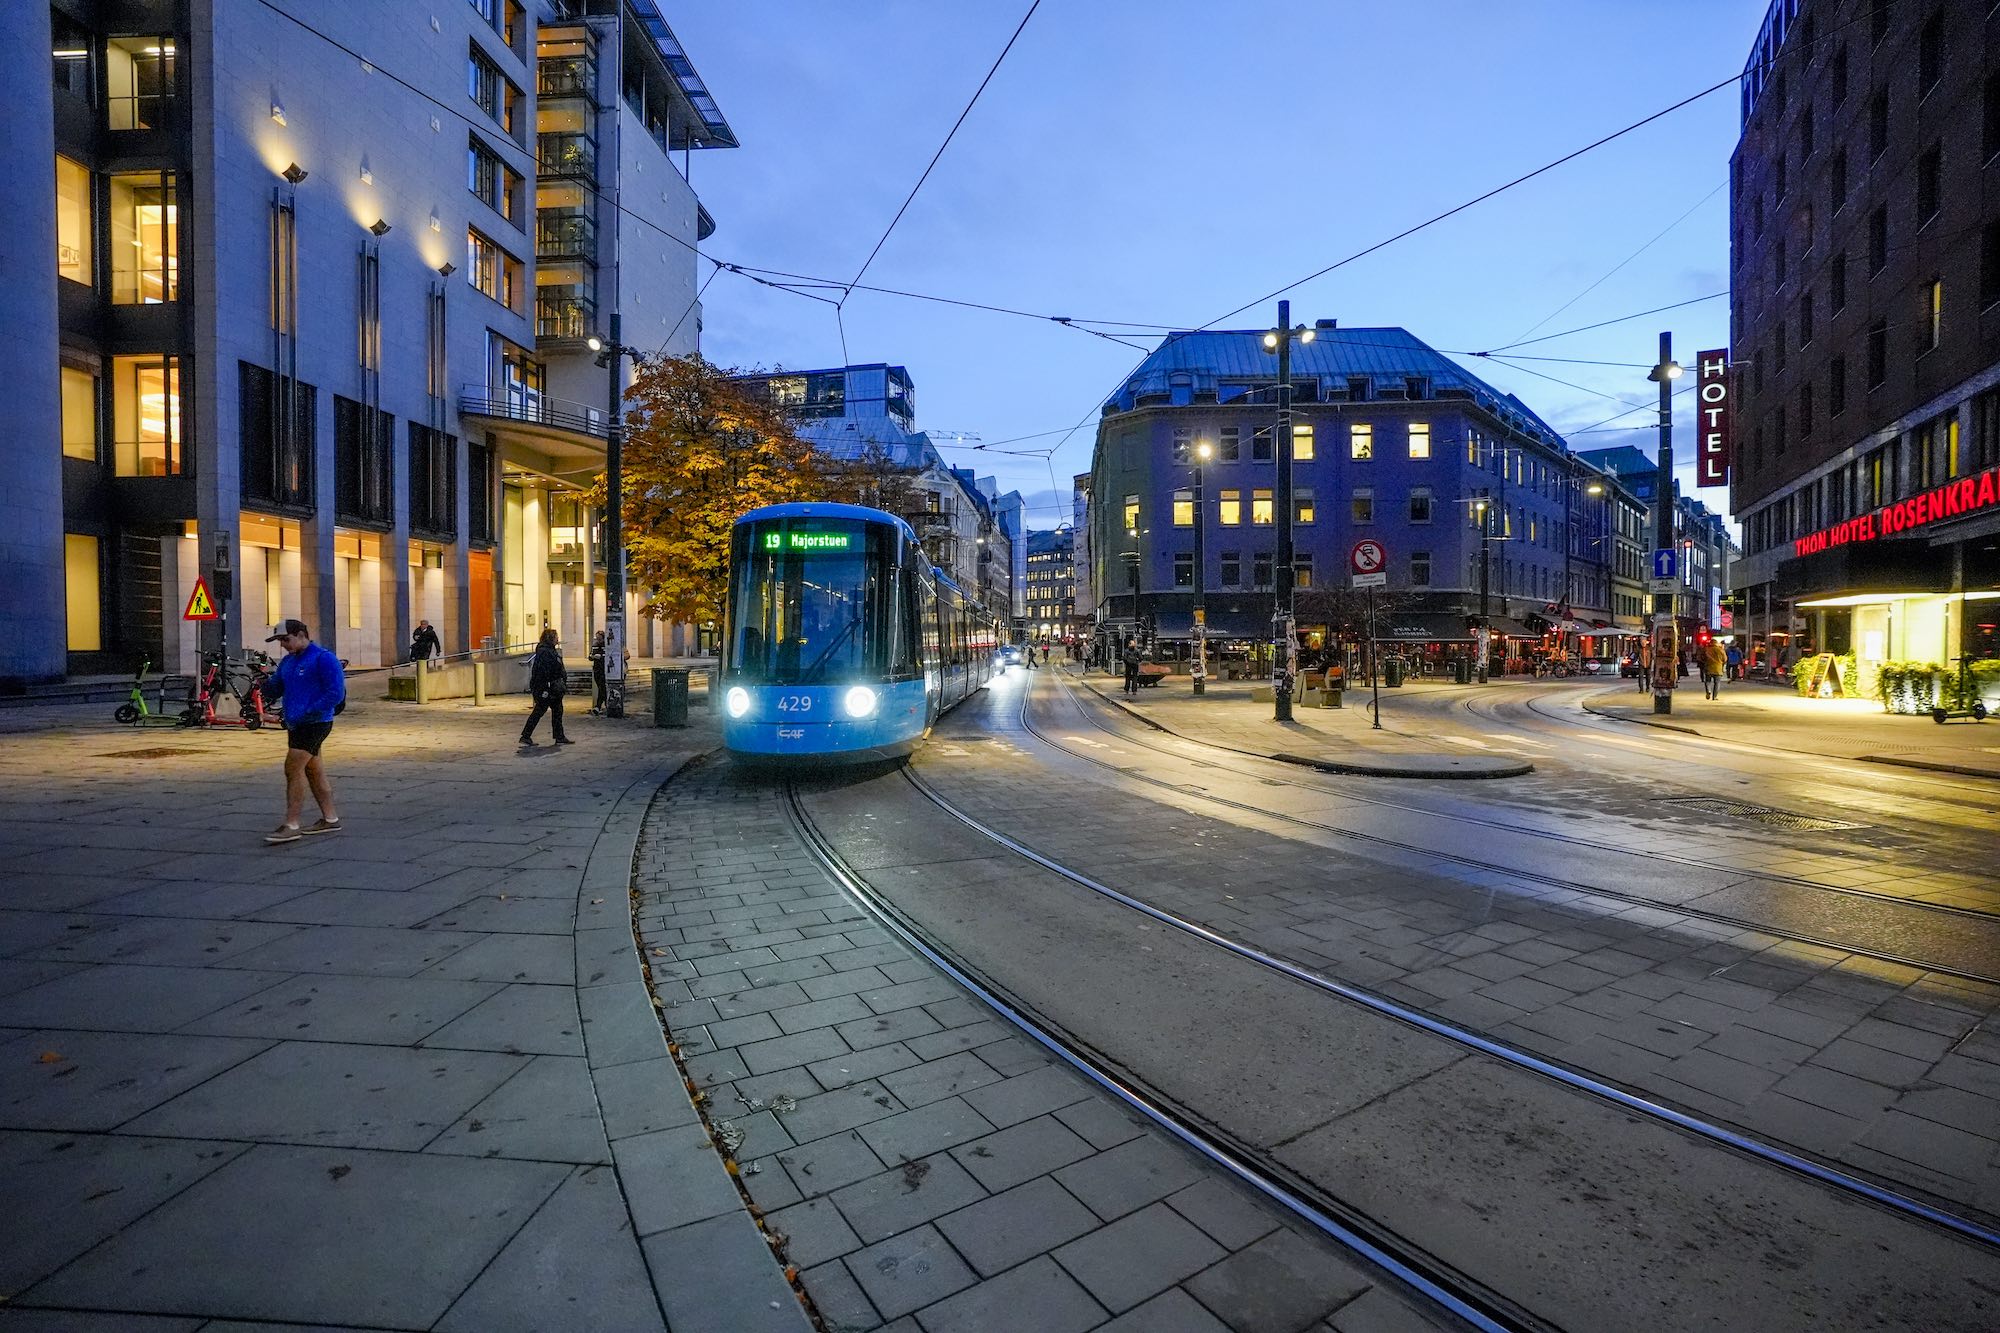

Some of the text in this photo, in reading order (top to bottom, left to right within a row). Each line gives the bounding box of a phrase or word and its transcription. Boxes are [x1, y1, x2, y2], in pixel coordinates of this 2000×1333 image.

[1702, 358, 1726, 477] HOTEL
[1796, 466, 2000, 557] THON HOTEL ROSENKRA
[766, 534, 848, 549] 19 Majorstuen
[778, 696, 812, 712] 429
